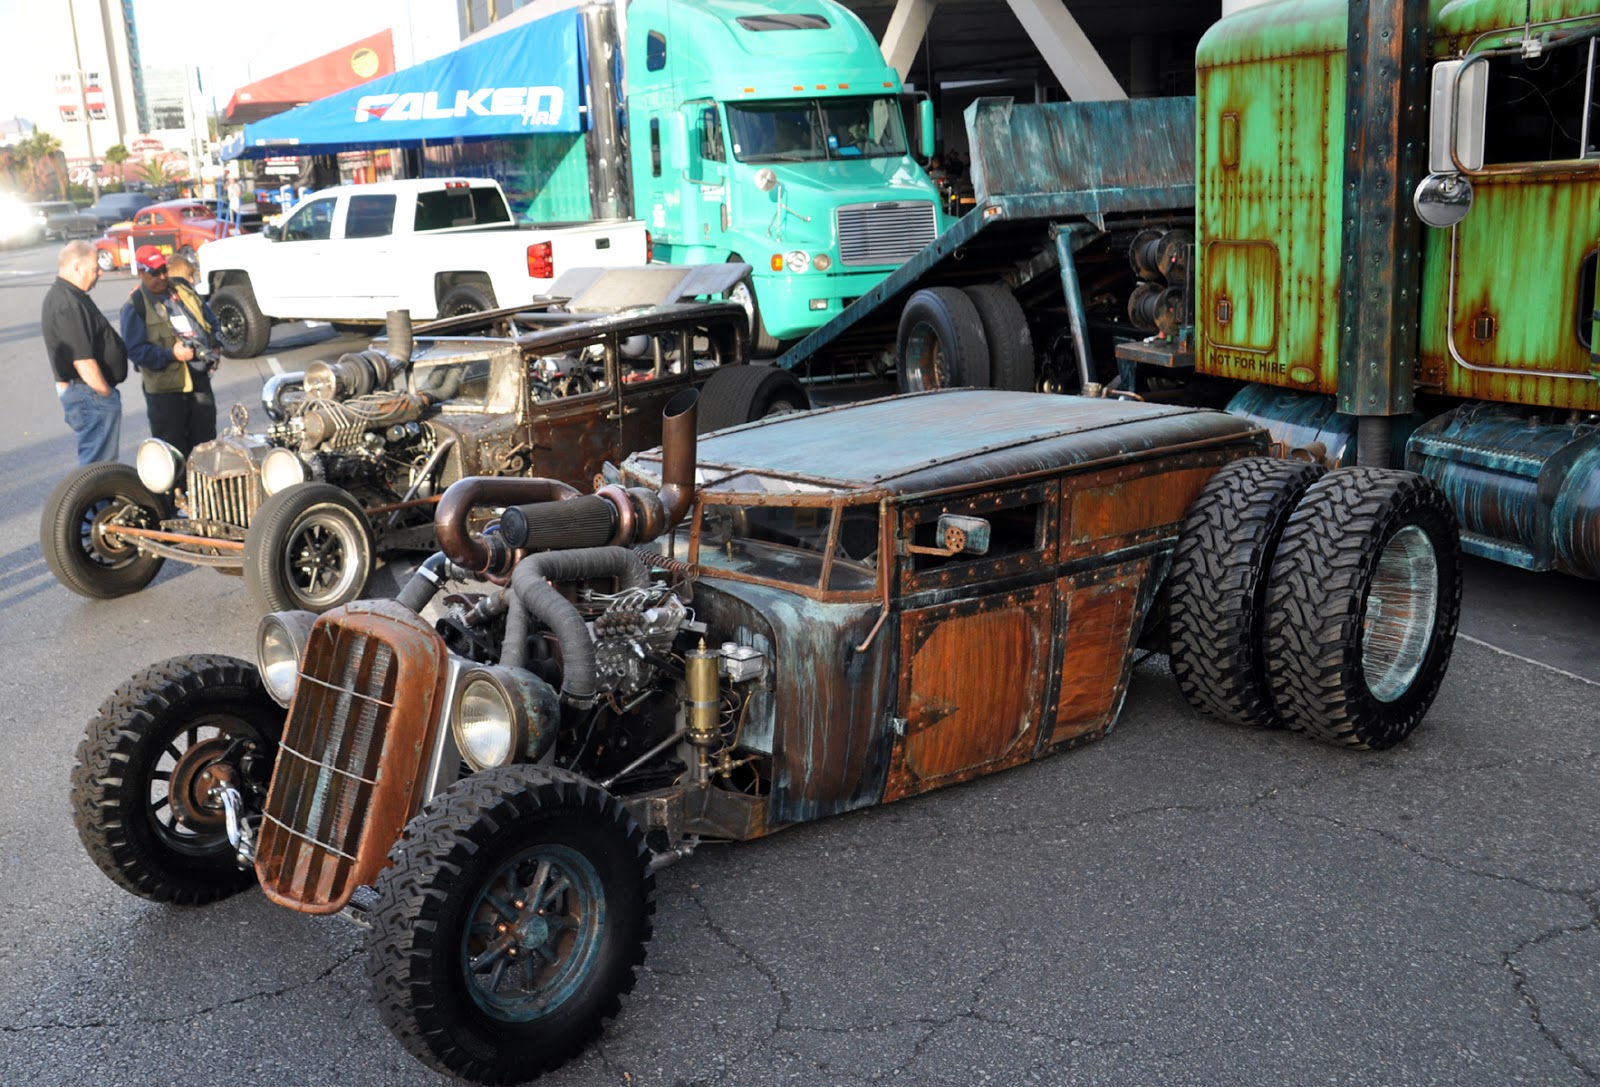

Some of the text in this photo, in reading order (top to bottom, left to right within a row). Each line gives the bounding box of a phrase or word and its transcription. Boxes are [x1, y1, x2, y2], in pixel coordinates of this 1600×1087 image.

[354, 86, 565, 123] FALKEN
[521, 111, 560, 126] TIRE
[1209, 352, 1286, 375] NOT FOR HIRE
